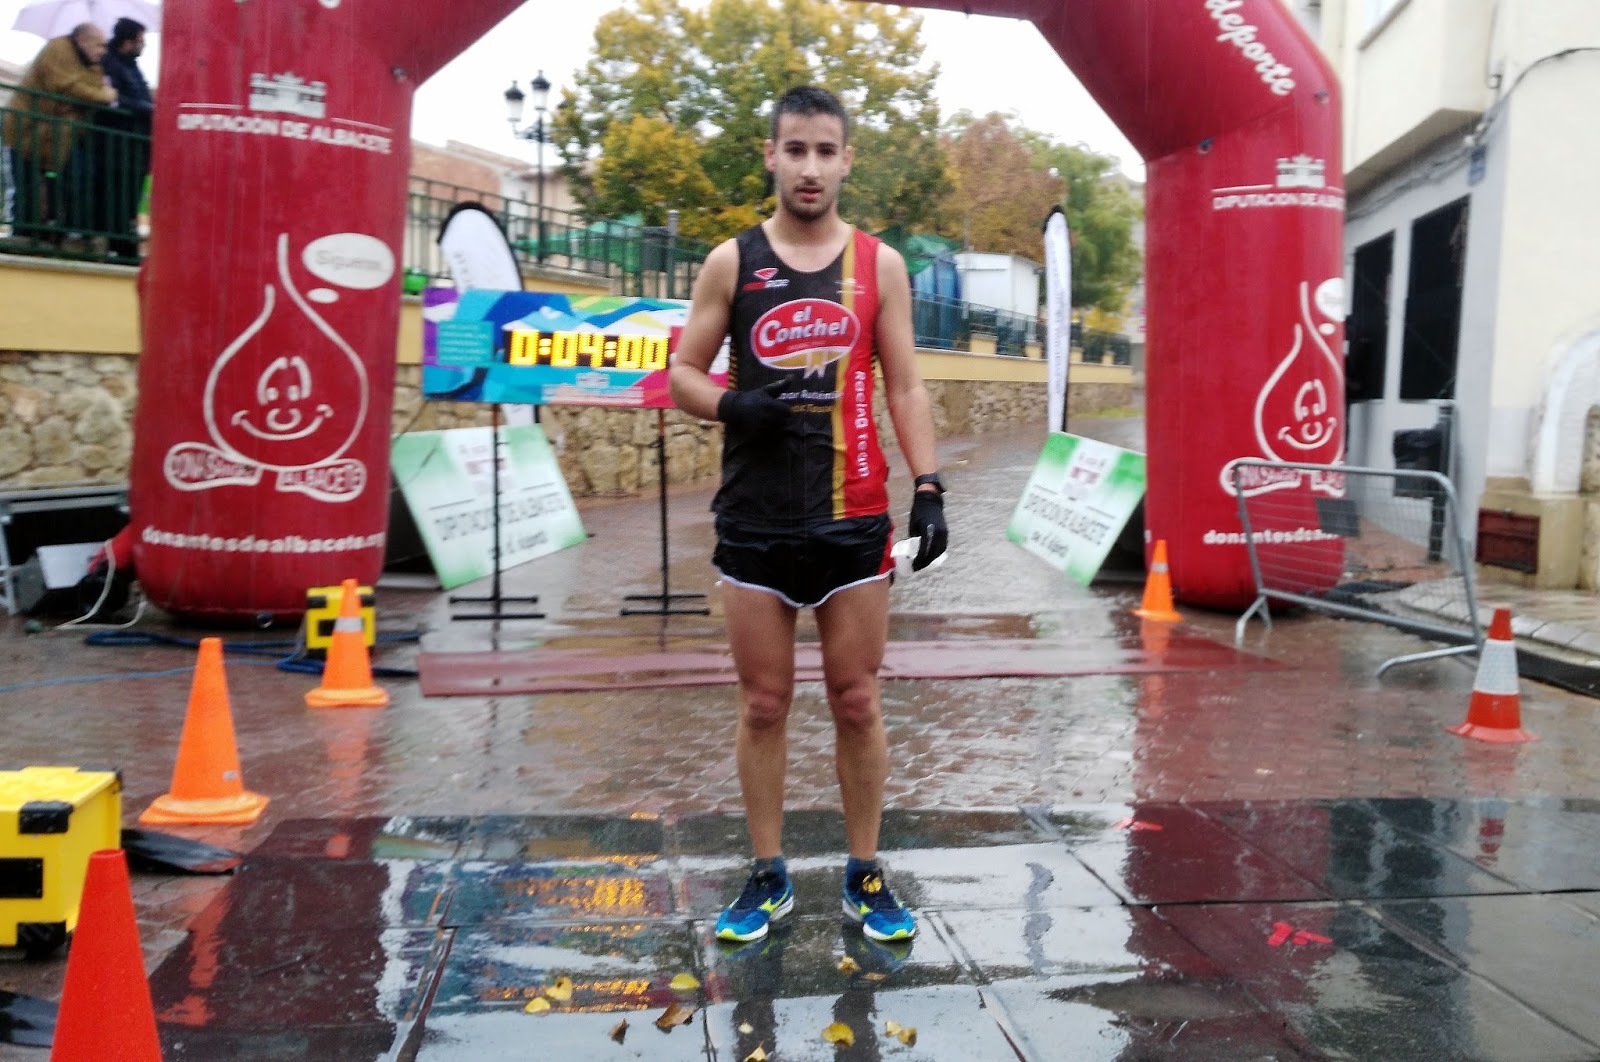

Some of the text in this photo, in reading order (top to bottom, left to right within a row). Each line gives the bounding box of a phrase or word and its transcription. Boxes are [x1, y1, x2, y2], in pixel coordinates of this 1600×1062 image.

[281, 120, 310, 141] DE
[310, 127, 393, 154] ALBACETE
[792, 305, 813, 324] el
[759, 316, 850, 348] Conchel
[508, 328, 669, 371] 0:04:00
